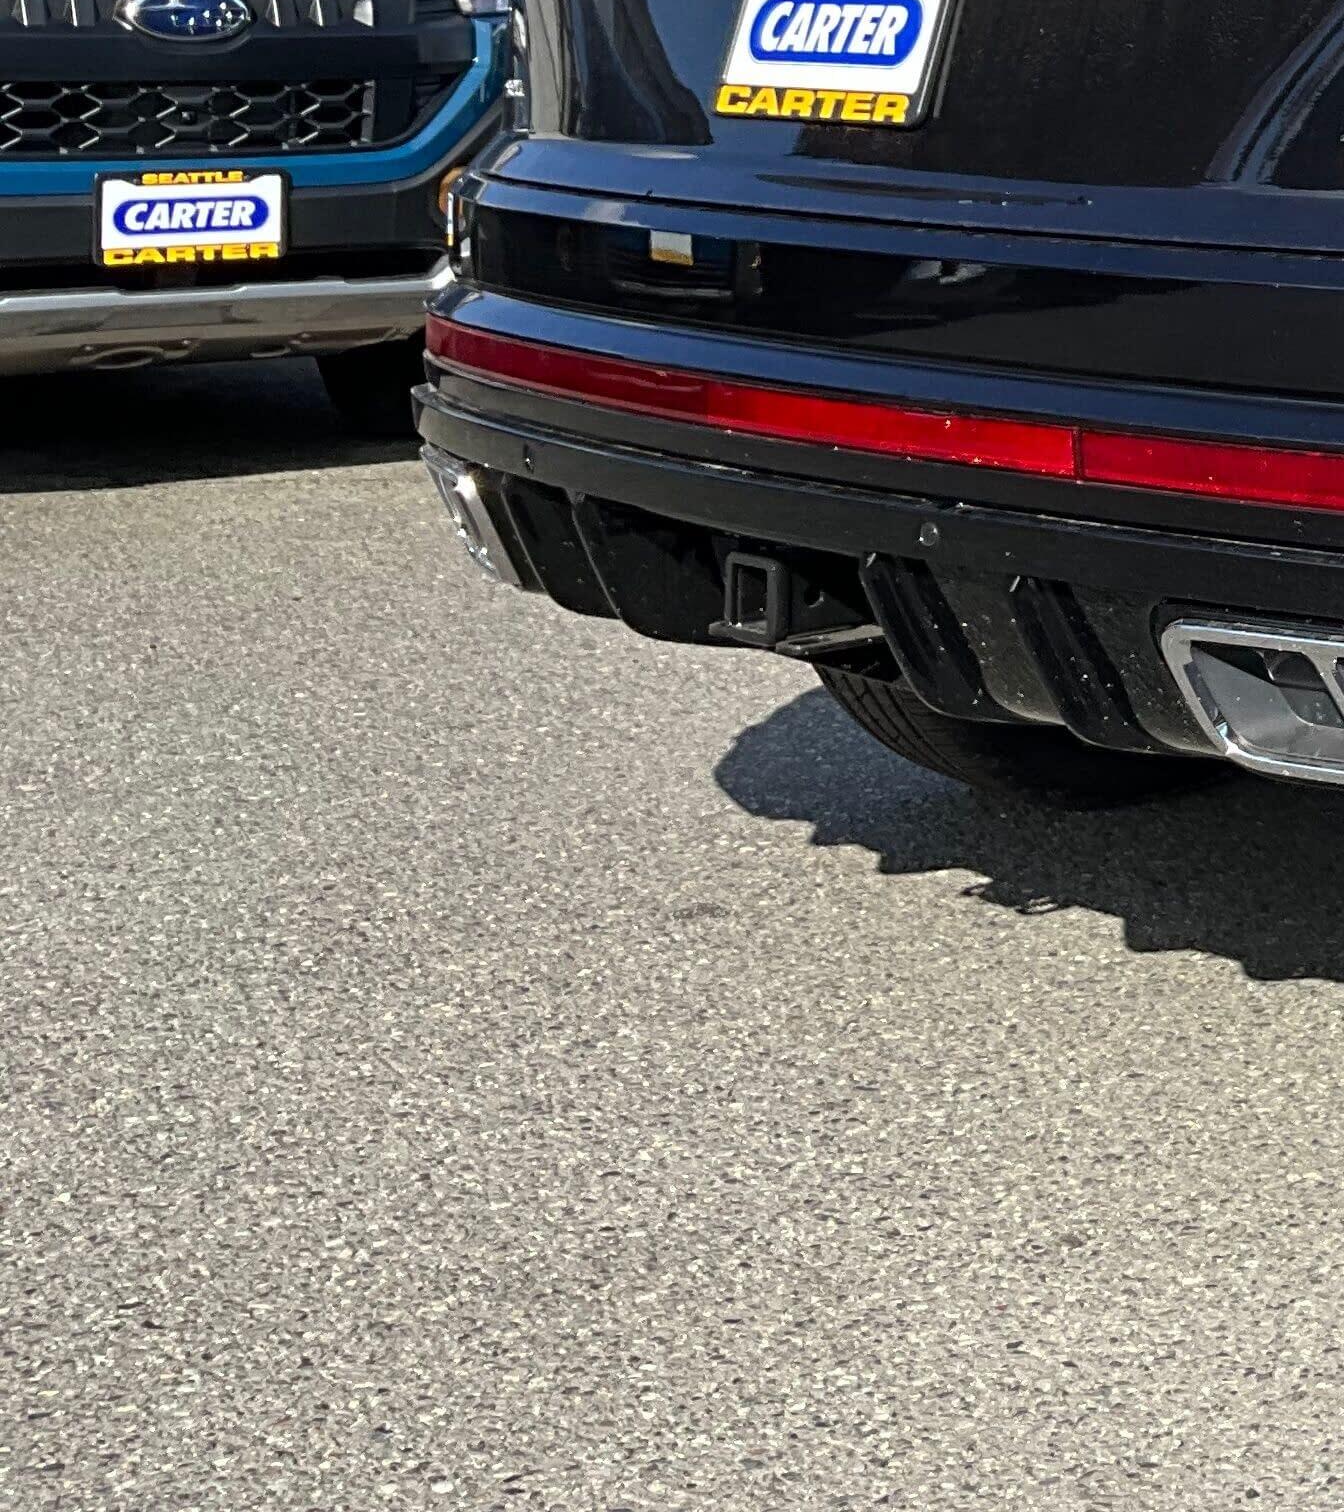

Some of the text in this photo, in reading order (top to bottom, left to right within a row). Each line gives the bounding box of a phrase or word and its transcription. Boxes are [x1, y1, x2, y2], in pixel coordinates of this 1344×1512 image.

[760, 0, 909, 57] CARTER
[716, 84, 910, 124] CARTER
[141, 170, 244, 186] SEATTLE
[124, 199, 256, 232] CARTER
[103, 242, 279, 265] CARTER
